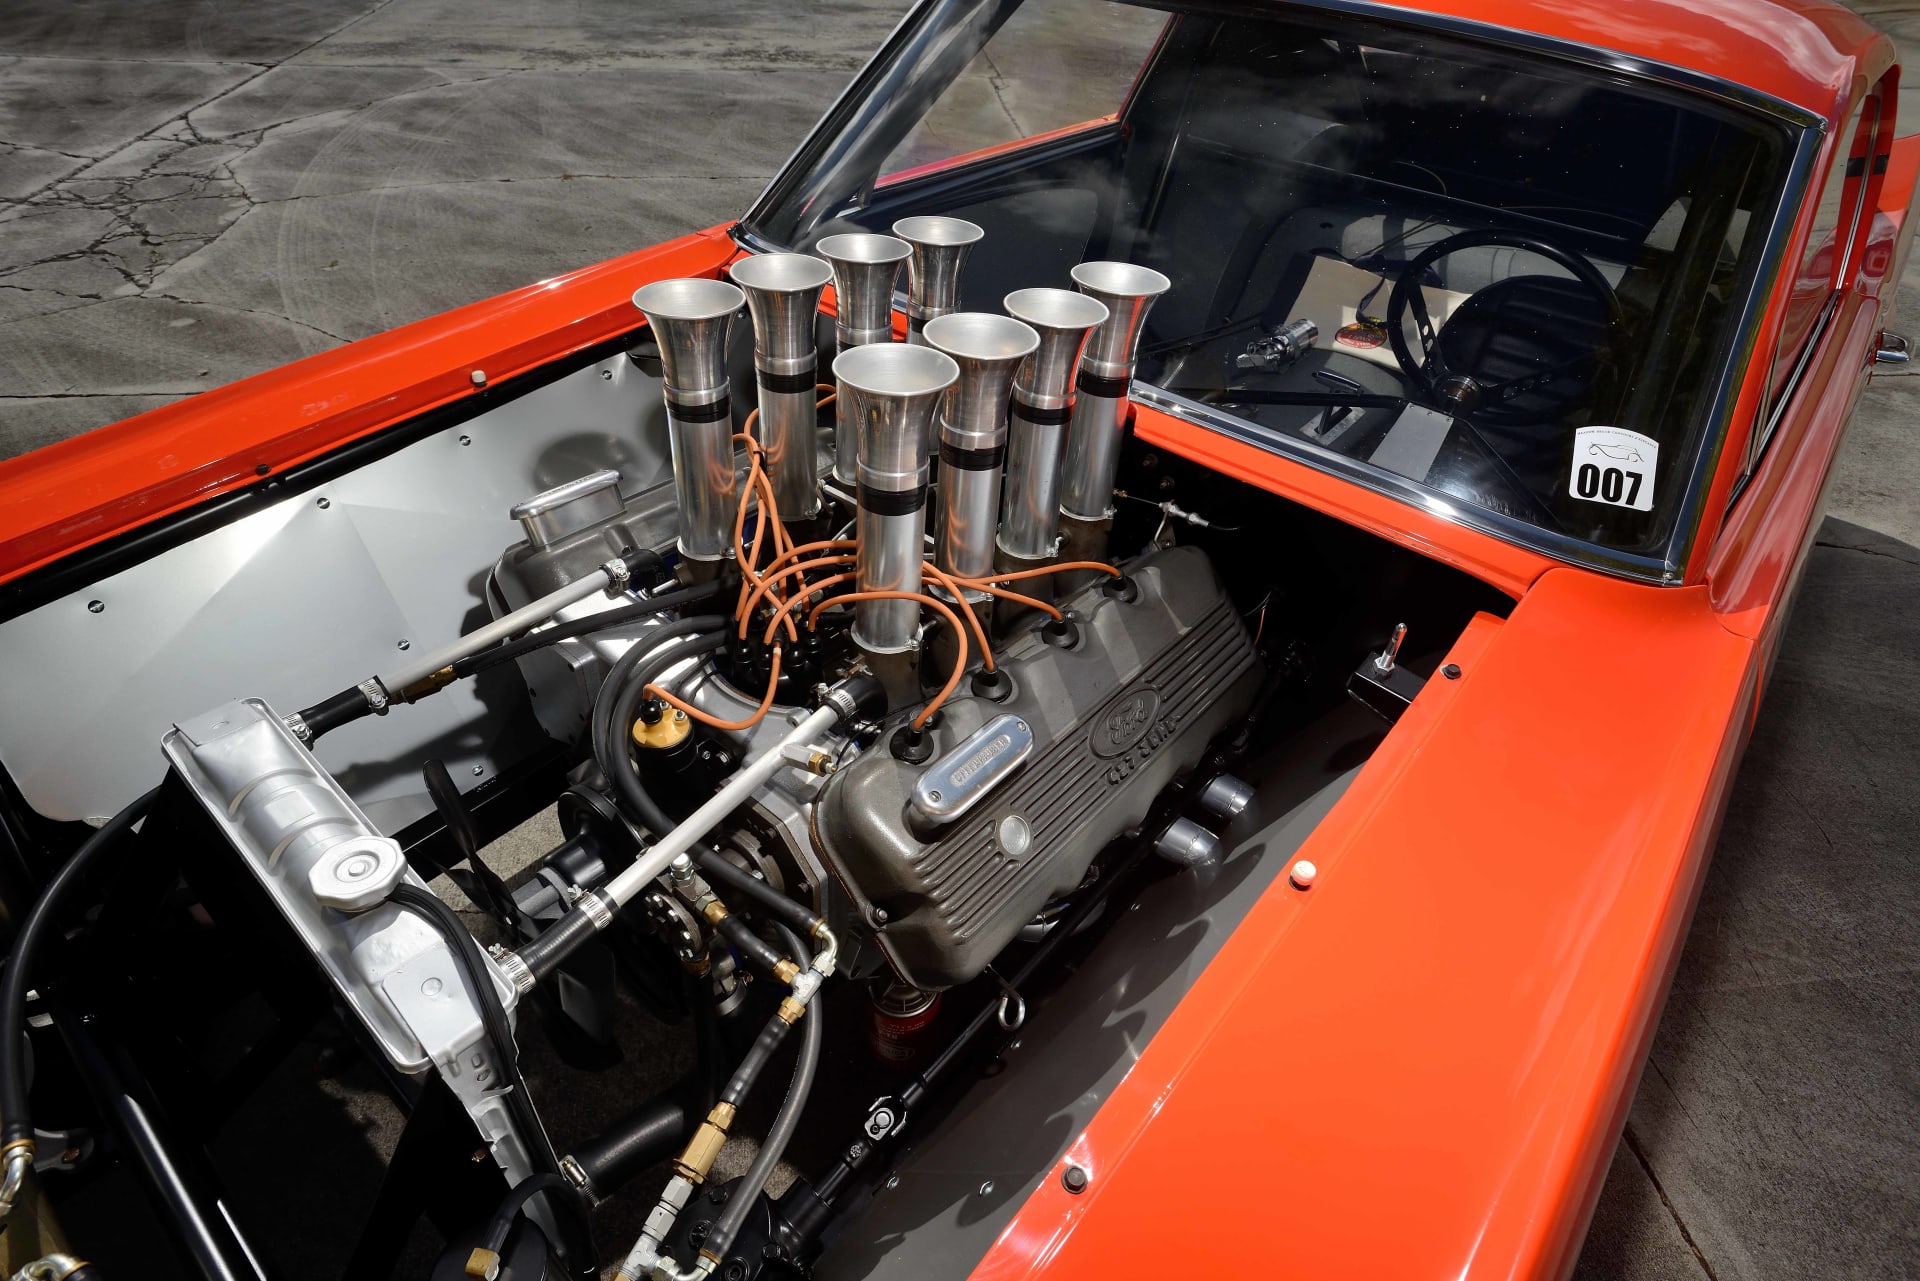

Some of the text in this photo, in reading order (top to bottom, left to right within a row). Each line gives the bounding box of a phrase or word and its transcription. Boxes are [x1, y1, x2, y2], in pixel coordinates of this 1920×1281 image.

[1577, 463, 1643, 506] 007
[1107, 698, 1148, 745] Ford
[1105, 757, 1135, 786] 427
